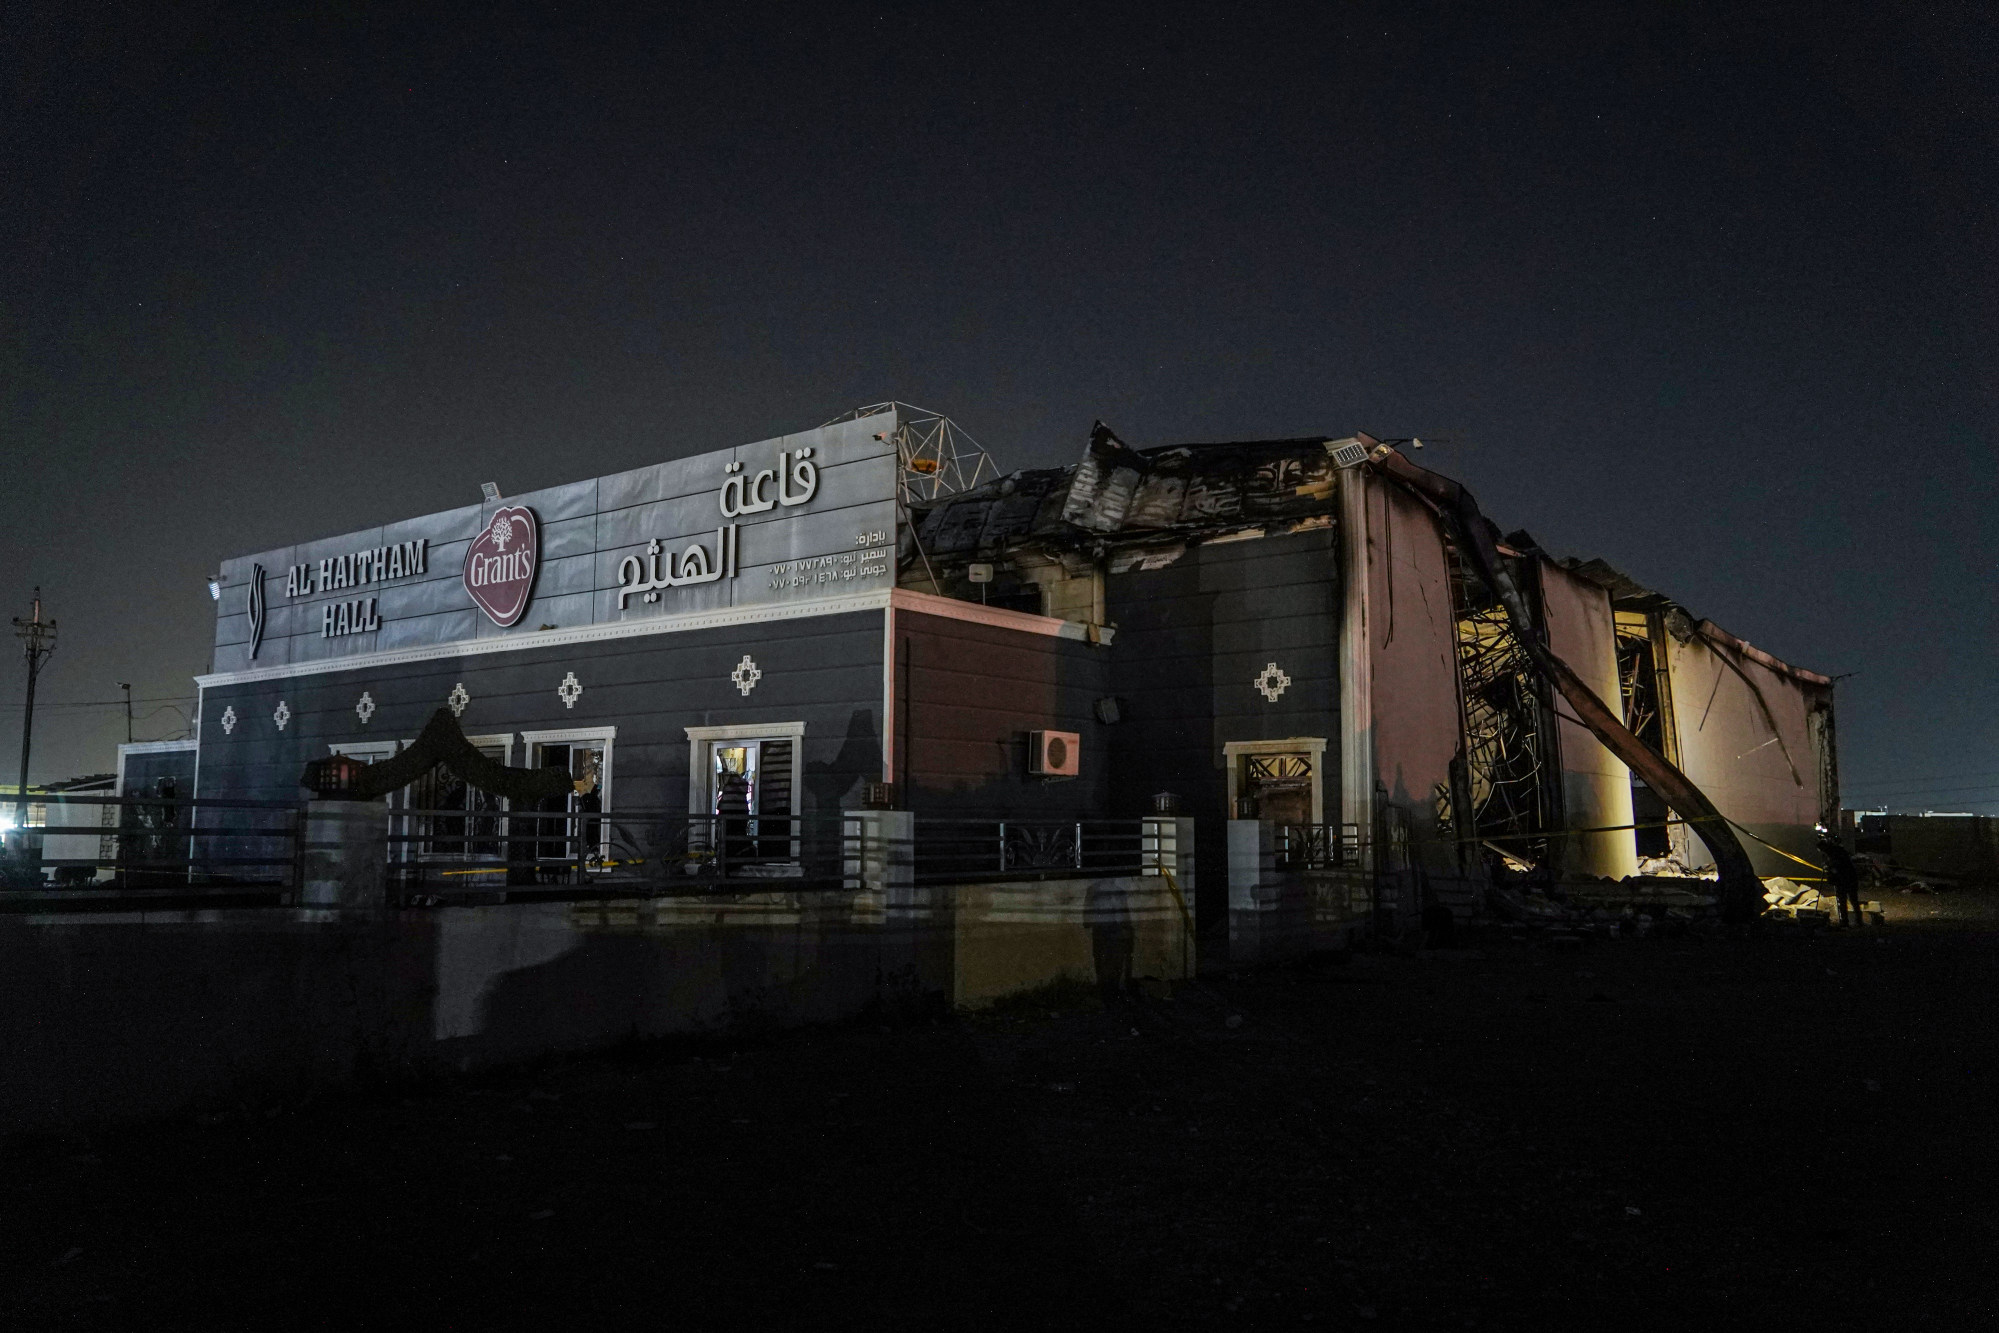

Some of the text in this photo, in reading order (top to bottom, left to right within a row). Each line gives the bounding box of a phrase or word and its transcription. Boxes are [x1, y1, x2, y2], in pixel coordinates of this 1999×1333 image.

[719, 446, 816, 518] قاعة
[286, 539, 428, 598] AL HAITHAM
[471, 545, 531, 587] Grant's
[617, 523, 736, 610] الهيثم
[321, 598, 381, 638] HALL
